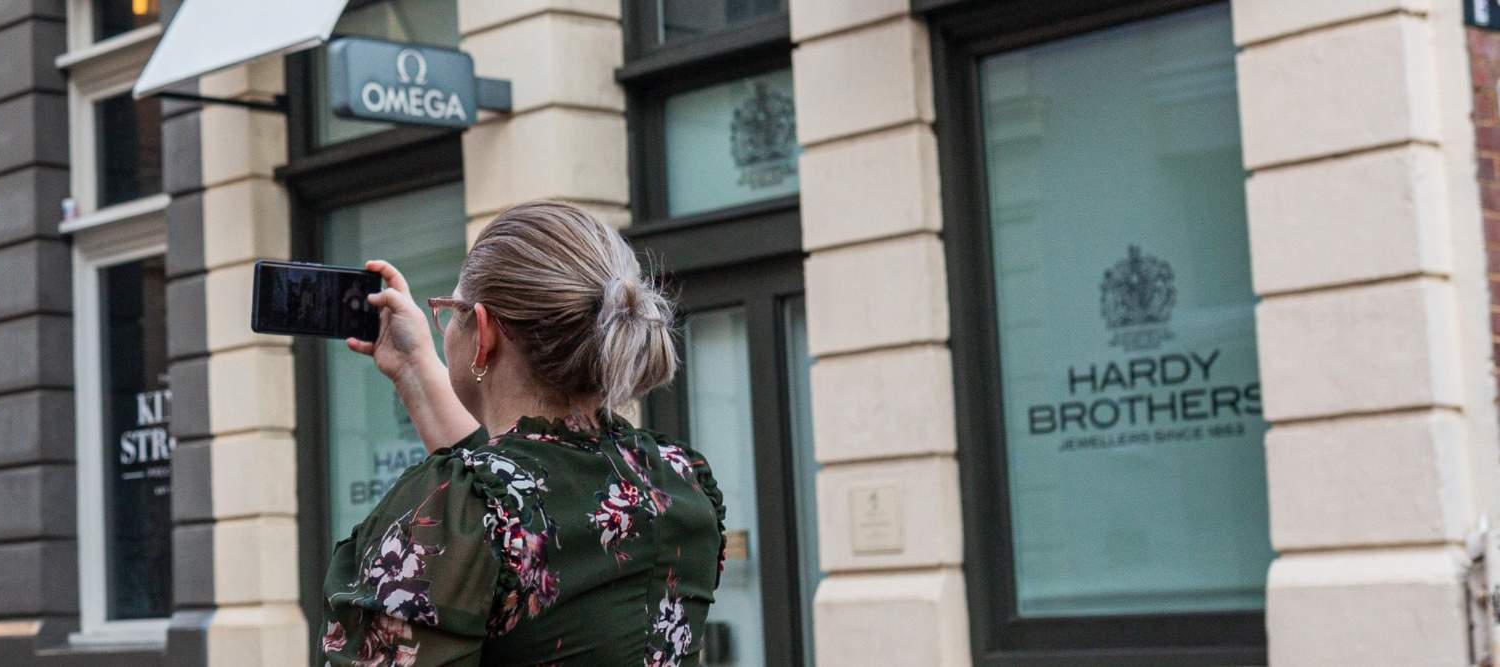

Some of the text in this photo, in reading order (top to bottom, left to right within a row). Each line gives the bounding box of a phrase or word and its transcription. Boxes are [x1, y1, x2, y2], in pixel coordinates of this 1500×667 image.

[362, 82, 467, 121] OMEGA
[1068, 349, 1220, 396] HARDY
[1028, 382, 1263, 436] BROTHERS
[373, 446, 427, 474] HAR
